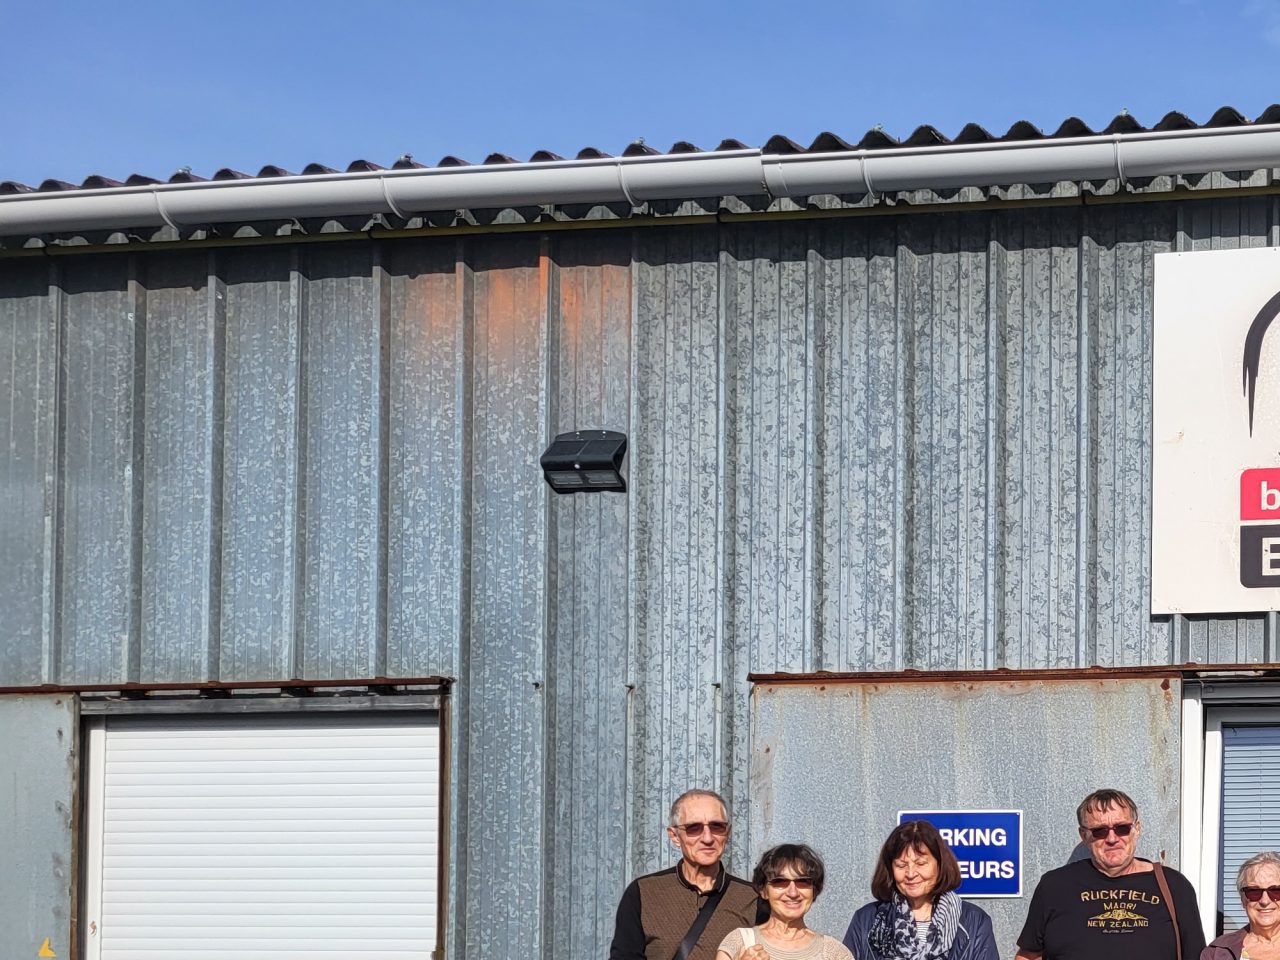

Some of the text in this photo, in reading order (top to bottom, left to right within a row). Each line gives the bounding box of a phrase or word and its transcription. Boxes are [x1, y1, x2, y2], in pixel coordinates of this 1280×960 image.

[939, 828, 1007, 846] RKING
[958, 861, 1015, 879] EURS
[1080, 890, 1160, 905] RUCKFIELD
[1103, 902, 1137, 910] MAORI
[1109, 920, 1149, 928] ZEALAND
